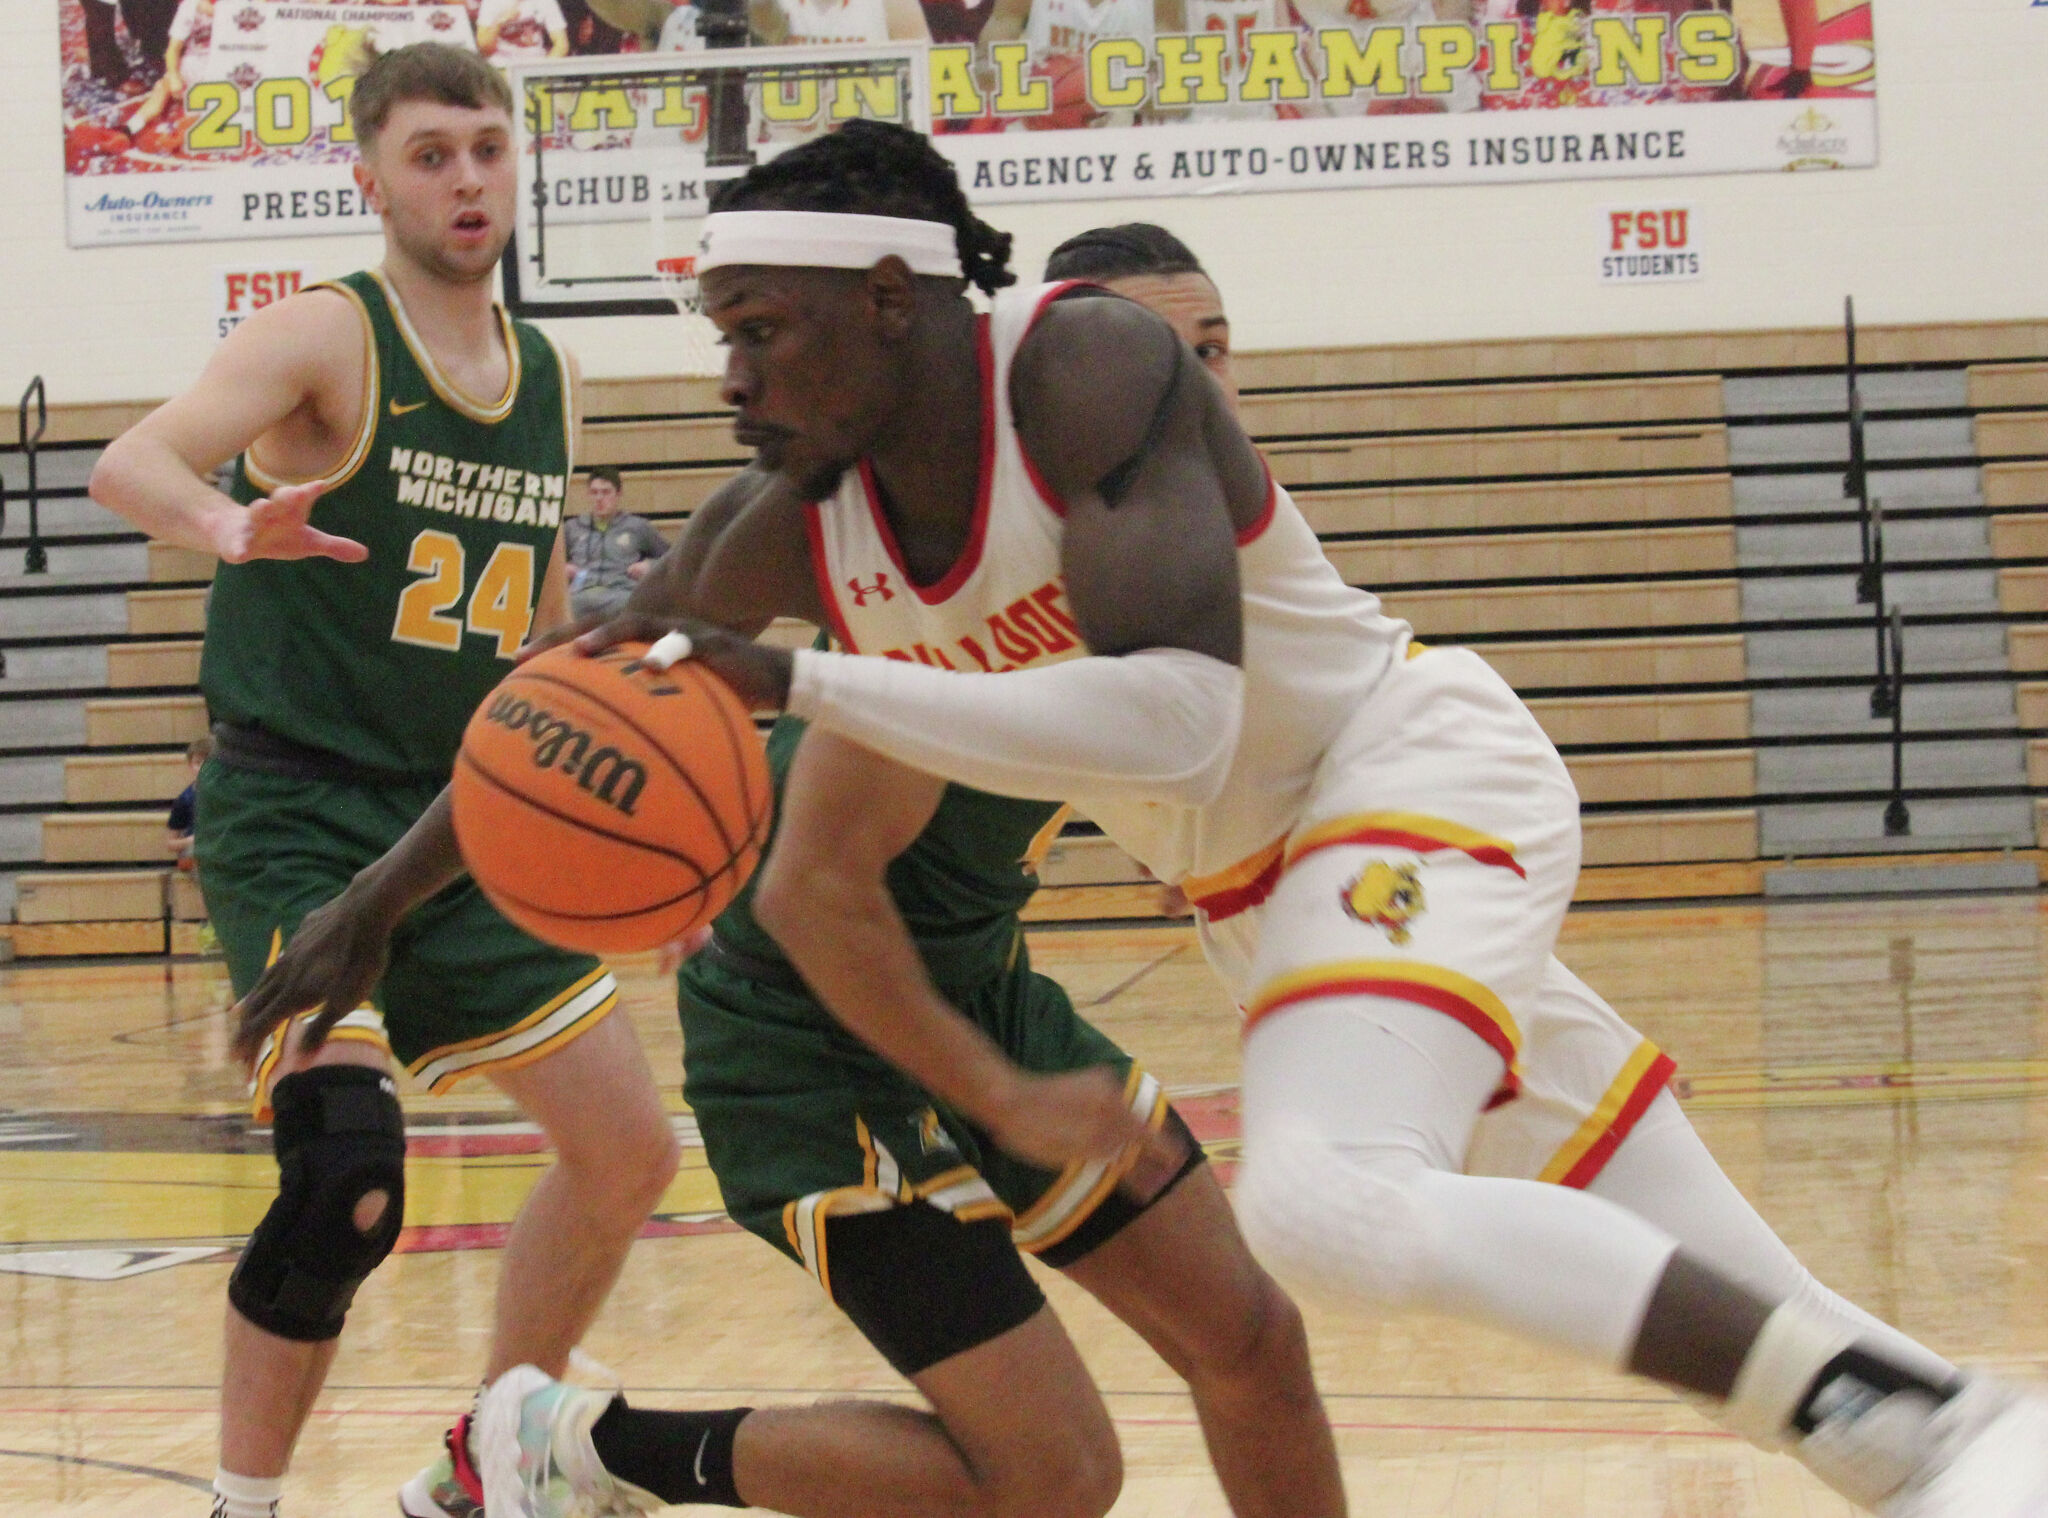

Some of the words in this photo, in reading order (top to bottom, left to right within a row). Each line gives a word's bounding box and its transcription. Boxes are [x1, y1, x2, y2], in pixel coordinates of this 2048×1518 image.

[186, 74, 356, 150] 201
[973, 154, 1118, 188] AGENCY
[1134, 153, 1154, 180] &
[1170, 140, 1451, 179] AUTO-OWNERS
[1468, 129, 1685, 167] INSURANCE
[85, 191, 214, 212] Auto-Owners
[110, 210, 188, 222] INSURANCE
[1609, 208, 1689, 251] FSU
[1602, 252, 1699, 278] STUDENTS
[389, 446, 565, 499] NORTHERN
[397, 475, 562, 529] MICHIGAN
[390, 528, 536, 661] 24
[486, 690, 647, 818] Wilson
